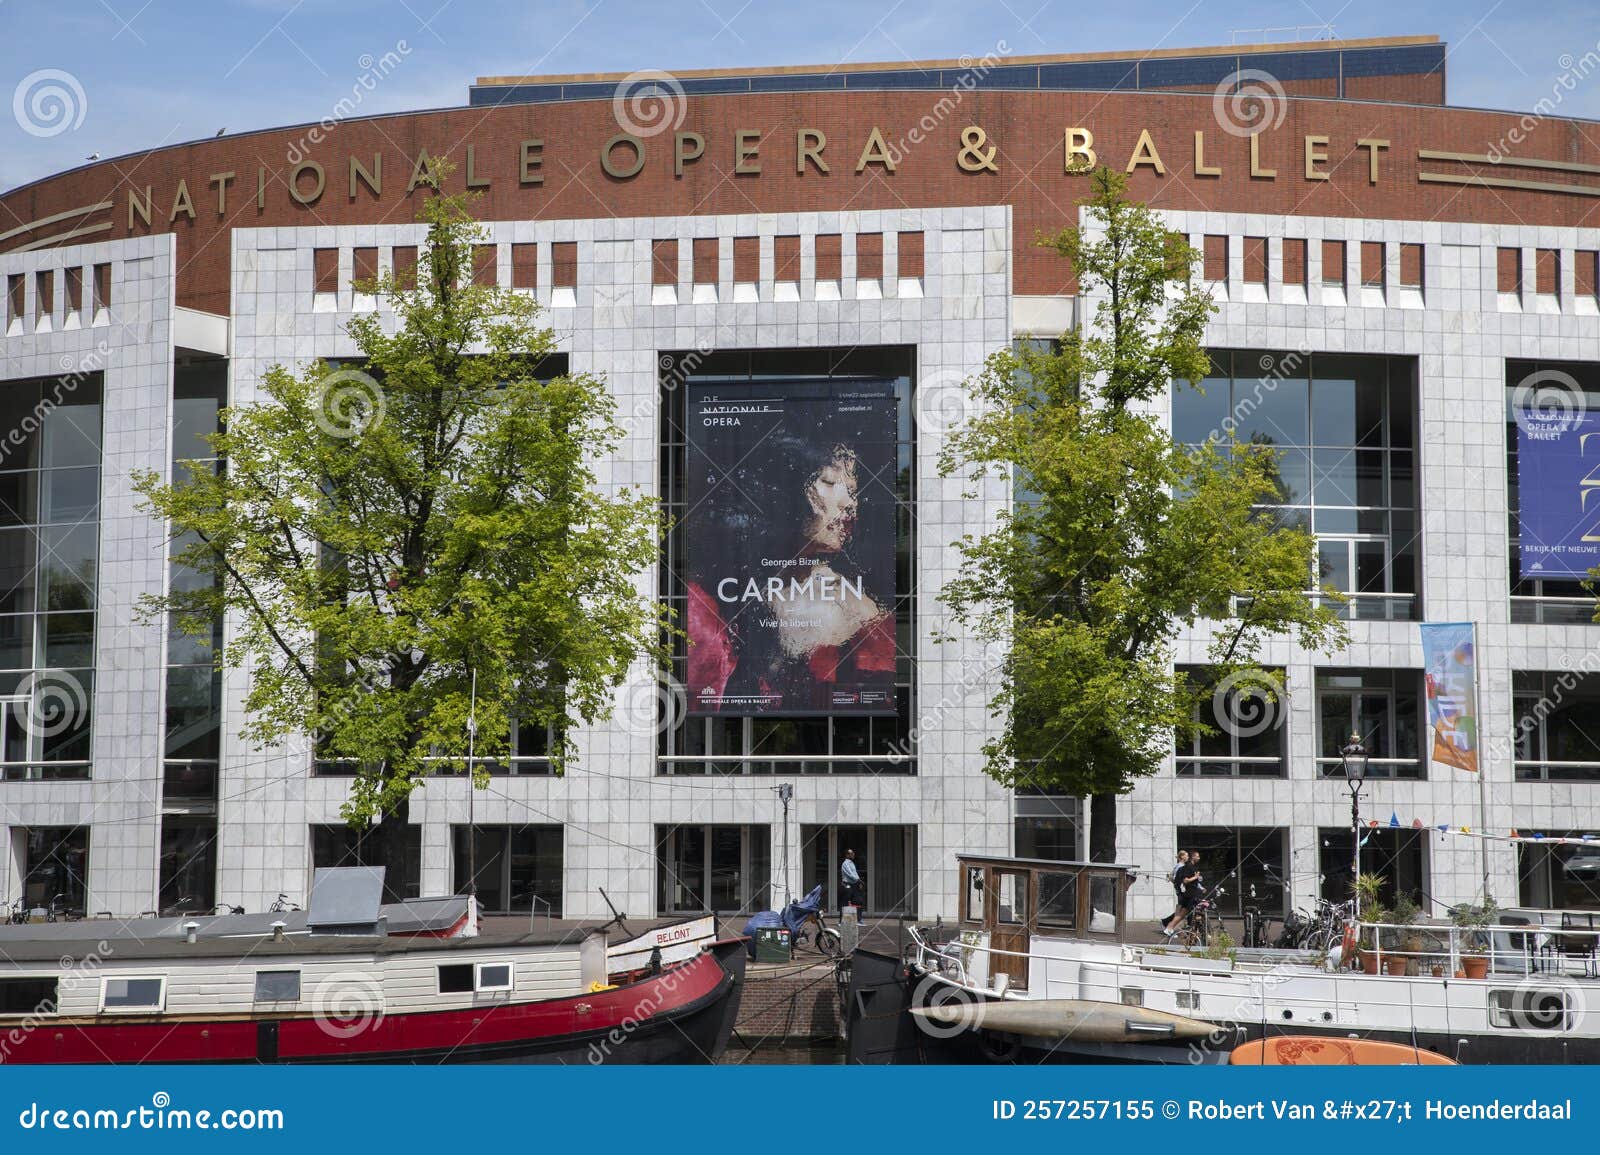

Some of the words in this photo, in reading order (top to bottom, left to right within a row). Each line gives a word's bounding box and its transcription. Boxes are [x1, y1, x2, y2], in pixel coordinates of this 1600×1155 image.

[128, 139, 545, 230] NATIONALE
[600, 126, 896, 178] OPERA
[957, 126, 999, 171] &
[1064, 127, 1391, 183] BALLET
[703, 418, 741, 426] OPERA
[1527, 423, 1559, 431] OPERA
[1527, 432, 1561, 440] BALLET
[1525, 545, 1550, 554] BEKIJK
[1551, 545, 1567, 553] HET
[1568, 546, 1598, 554] NIEUWE
[761, 558, 797, 568] Georges
[799, 557, 820, 566] Bizet
[717, 575, 863, 603] CARMEN
[759, 618, 778, 628] Vive
[780, 617, 789, 628] la
[656, 927, 691, 944] BELONT
